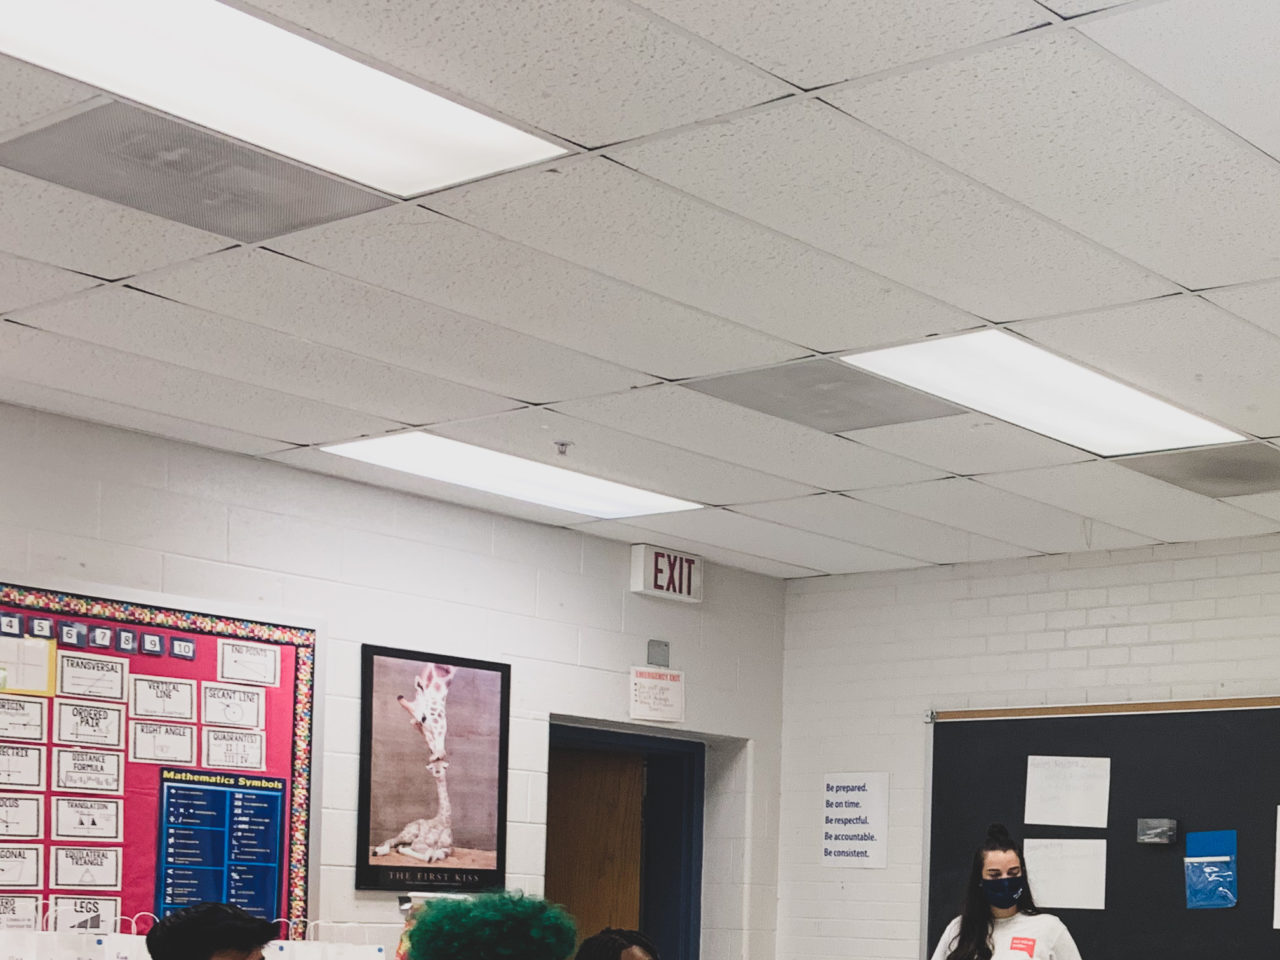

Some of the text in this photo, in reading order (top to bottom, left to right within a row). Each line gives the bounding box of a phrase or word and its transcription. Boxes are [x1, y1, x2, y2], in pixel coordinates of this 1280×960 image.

[653, 552, 695, 596] EXIT
[6, 620, 14, 628] 4
[38, 622, 44, 632] 5
[66, 630, 73, 638] 6
[101, 632, 107, 640] 7
[124, 636, 130, 645] 8
[150, 640, 157, 648] 9
[178, 644, 190, 654] 10
[66, 658, 118, 674] TRANSVERSAL
[148, 682, 180, 692] VERTICAL
[156, 690, 172, 700] LINE
[209, 688, 256, 703] SECANT LINE
[72, 706, 108, 720] ORDERED
[80, 716, 100, 728] PAIR
[141, 724, 186, 736] RIGHT ANGLE
[213, 732, 257, 744] QUADRANT(S)
[72, 752, 105, 764] DISTANCE
[74, 762, 104, 772] FORMULA
[162, 770, 283, 790] Mathematics Symbols
[826, 782, 868, 794] Be prepared.
[67, 800, 108, 810] TRANSLATION
[826, 800, 834, 808] Be
[844, 800, 862, 808] time.
[825, 816, 869, 826] Be respectful.
[824, 832, 878, 842] Be accountable.
[65, 850, 109, 860] EQUILATERAL
[824, 848, 870, 858] Be consistent.
[72, 858, 104, 867] TRIANGLE
[389, 872, 480, 882] THE FIRST KISS
[74, 901, 100, 914] LEGS
